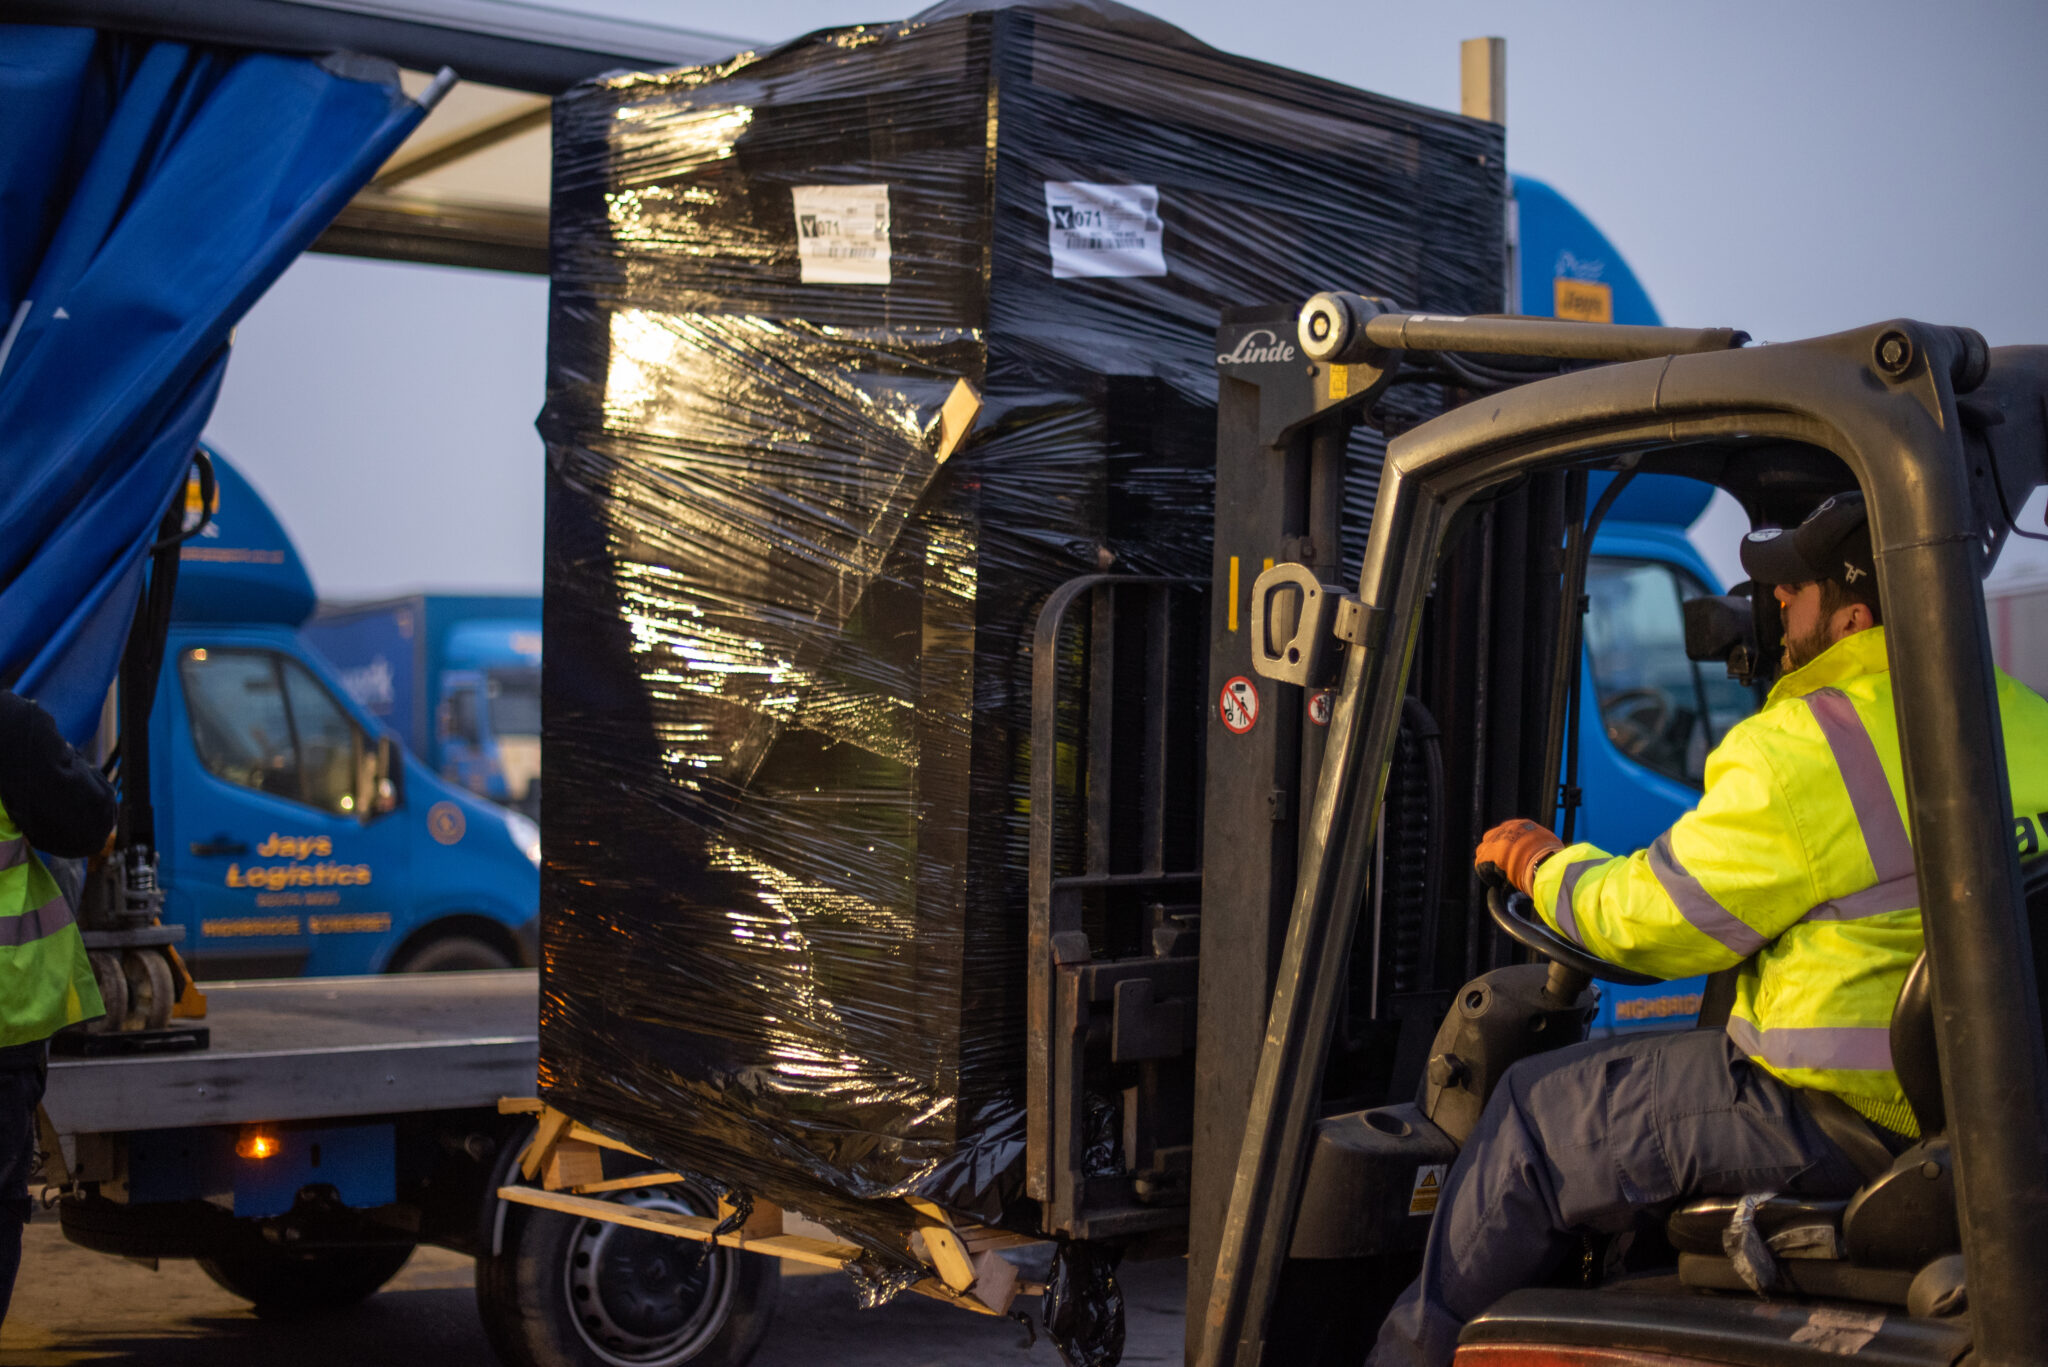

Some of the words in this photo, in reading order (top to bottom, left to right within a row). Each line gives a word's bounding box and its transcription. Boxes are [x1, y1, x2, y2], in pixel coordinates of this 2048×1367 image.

[1216, 329, 1295, 364] Linde
[257, 832, 332, 860] Jays
[225, 861, 371, 891] Logistics
